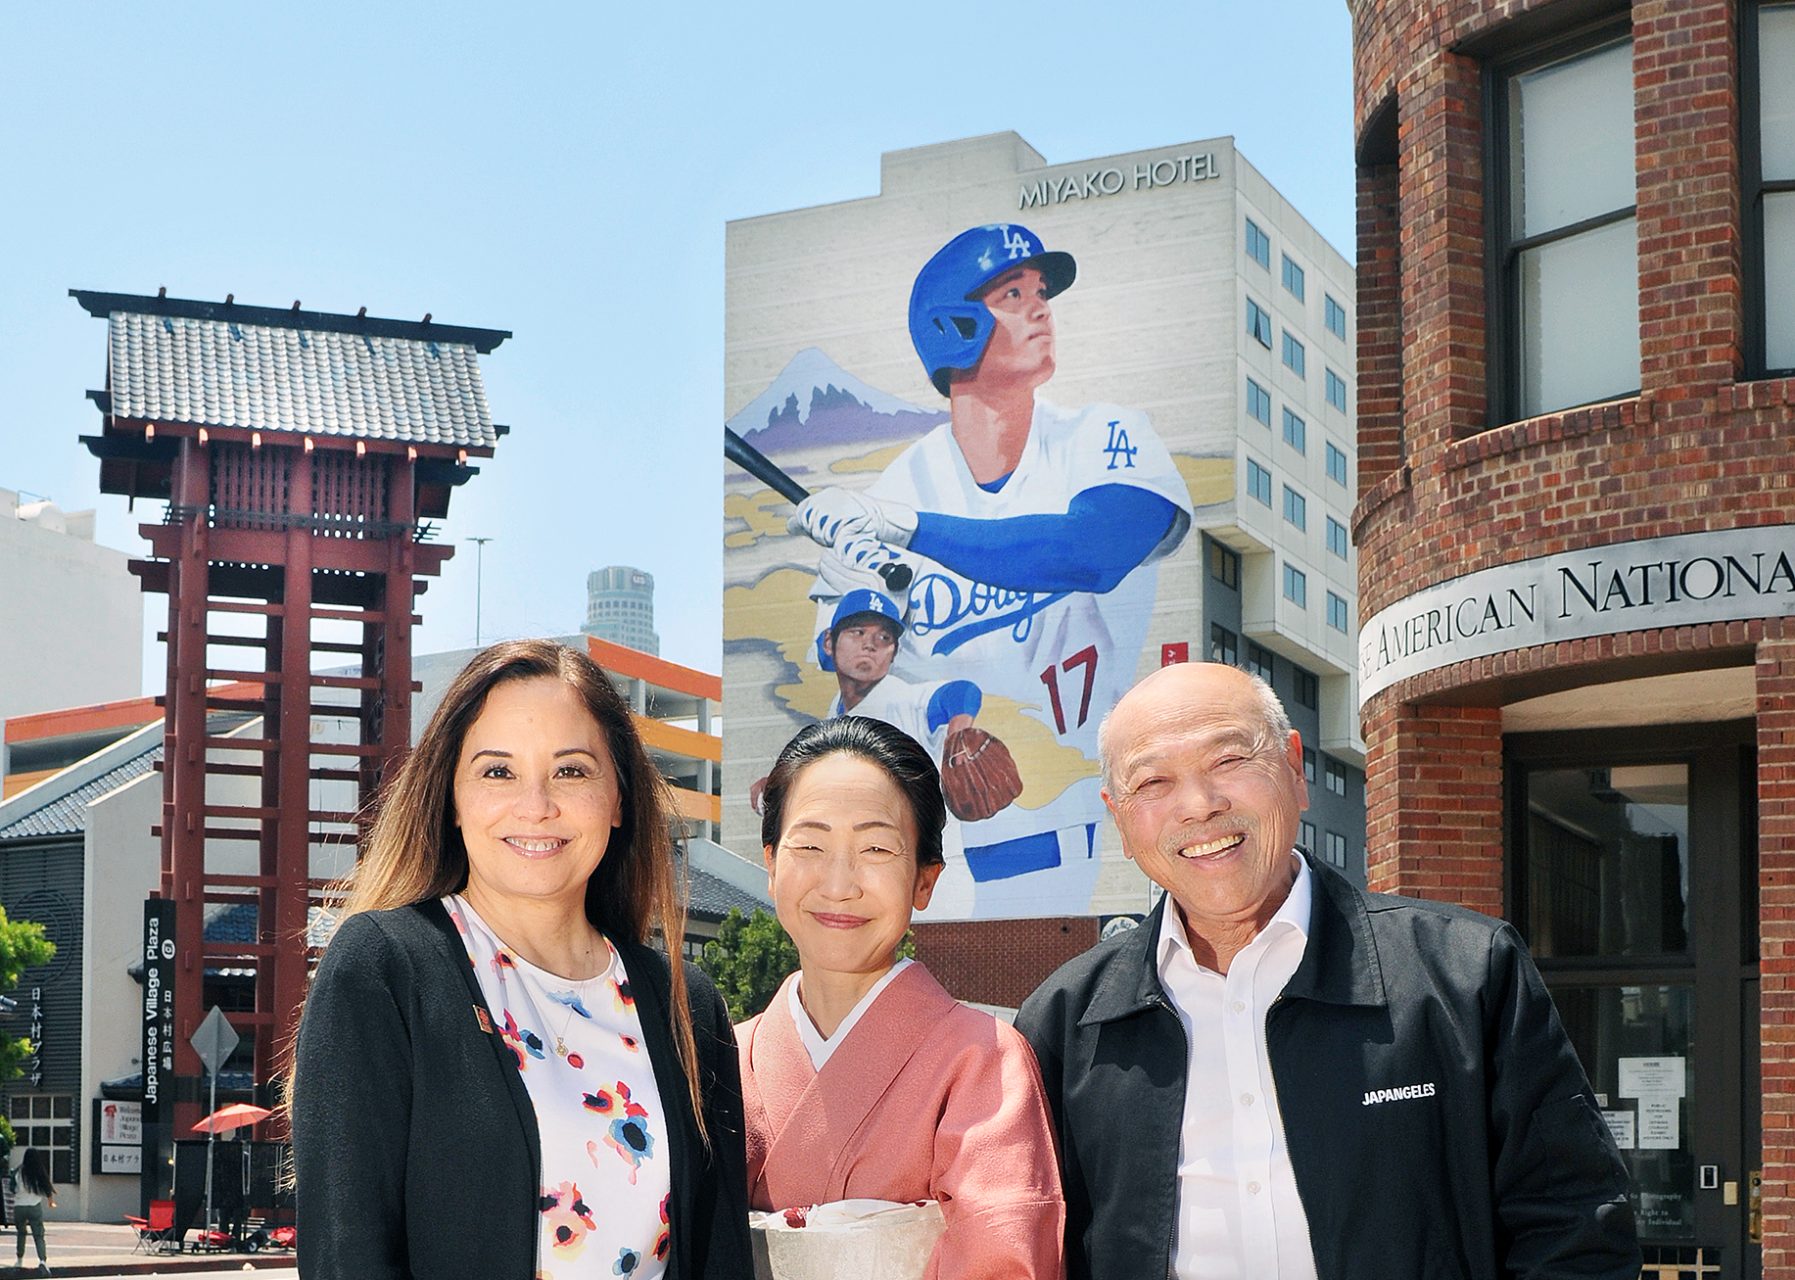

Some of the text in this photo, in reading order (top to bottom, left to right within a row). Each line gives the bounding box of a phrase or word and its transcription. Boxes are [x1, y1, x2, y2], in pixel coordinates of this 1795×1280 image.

[1018, 153, 1220, 210] MIYAKO HOTEL
[999, 223, 1031, 259] LA
[1103, 420, 1138, 470] LA
[1376, 583, 1538, 672] AMERICAN
[1557, 550, 1795, 619] NATIONA
[1039, 644, 1099, 736] 17
[144, 917, 160, 1104] Japanese Village Plaza
[1361, 1082, 1436, 1106] JAPANGELES
